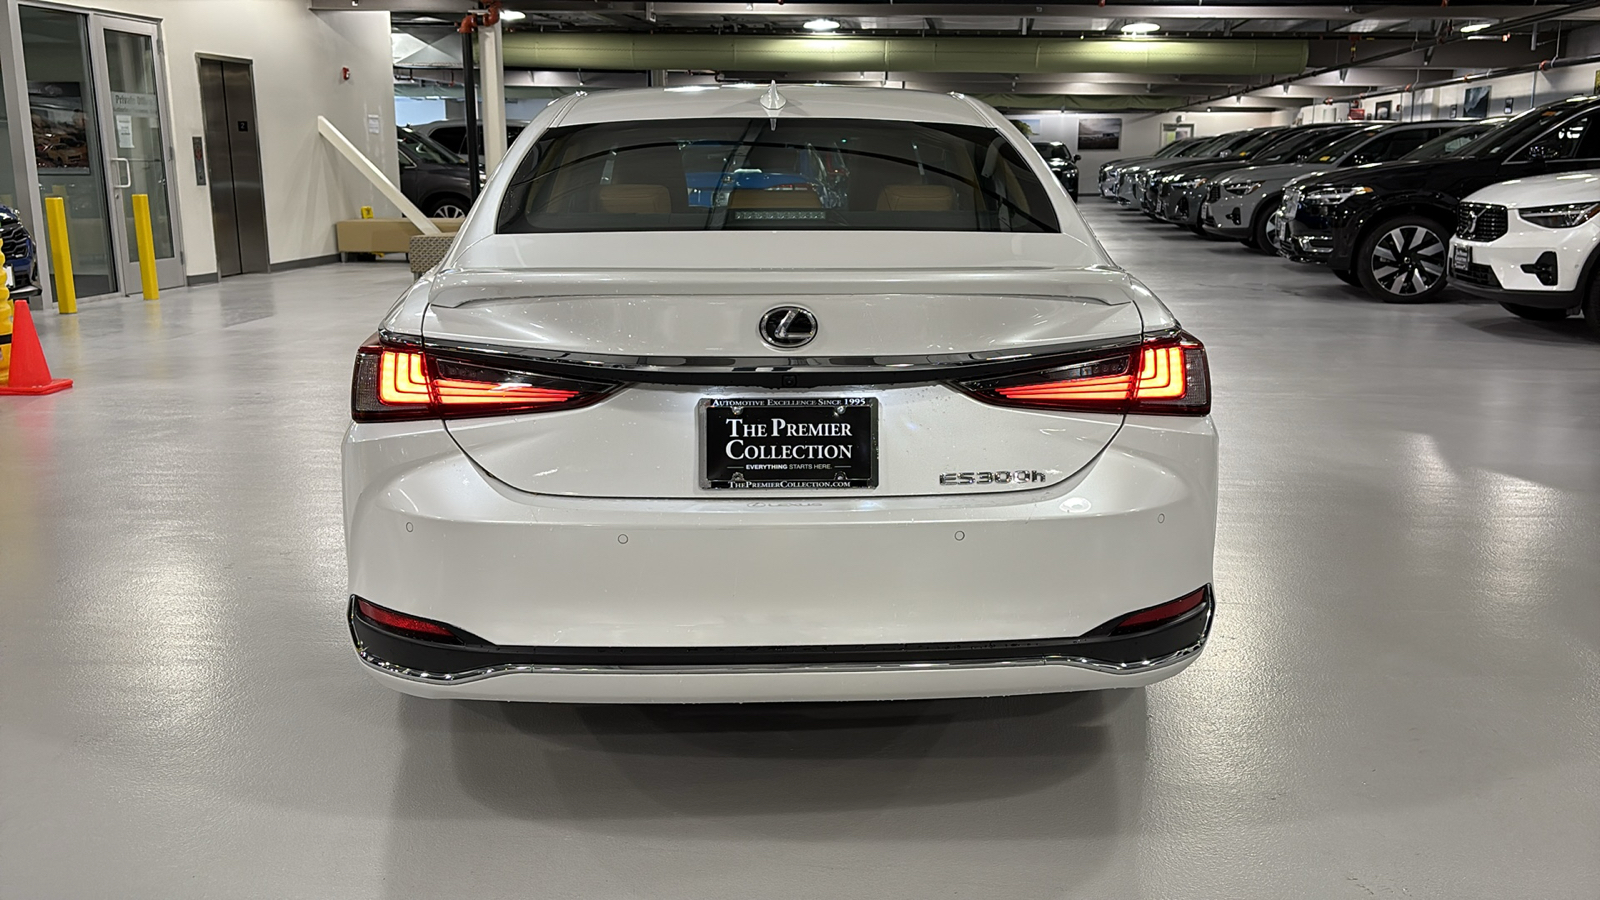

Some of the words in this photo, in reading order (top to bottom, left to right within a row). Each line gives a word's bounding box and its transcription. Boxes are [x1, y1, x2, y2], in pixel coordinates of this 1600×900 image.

[844, 398, 866, 406] 1995
[725, 418, 768, 438] THE
[770, 418, 853, 437] PREMIER
[725, 439, 853, 460] COLLECTION
[939, 470, 1046, 486] ES300h
